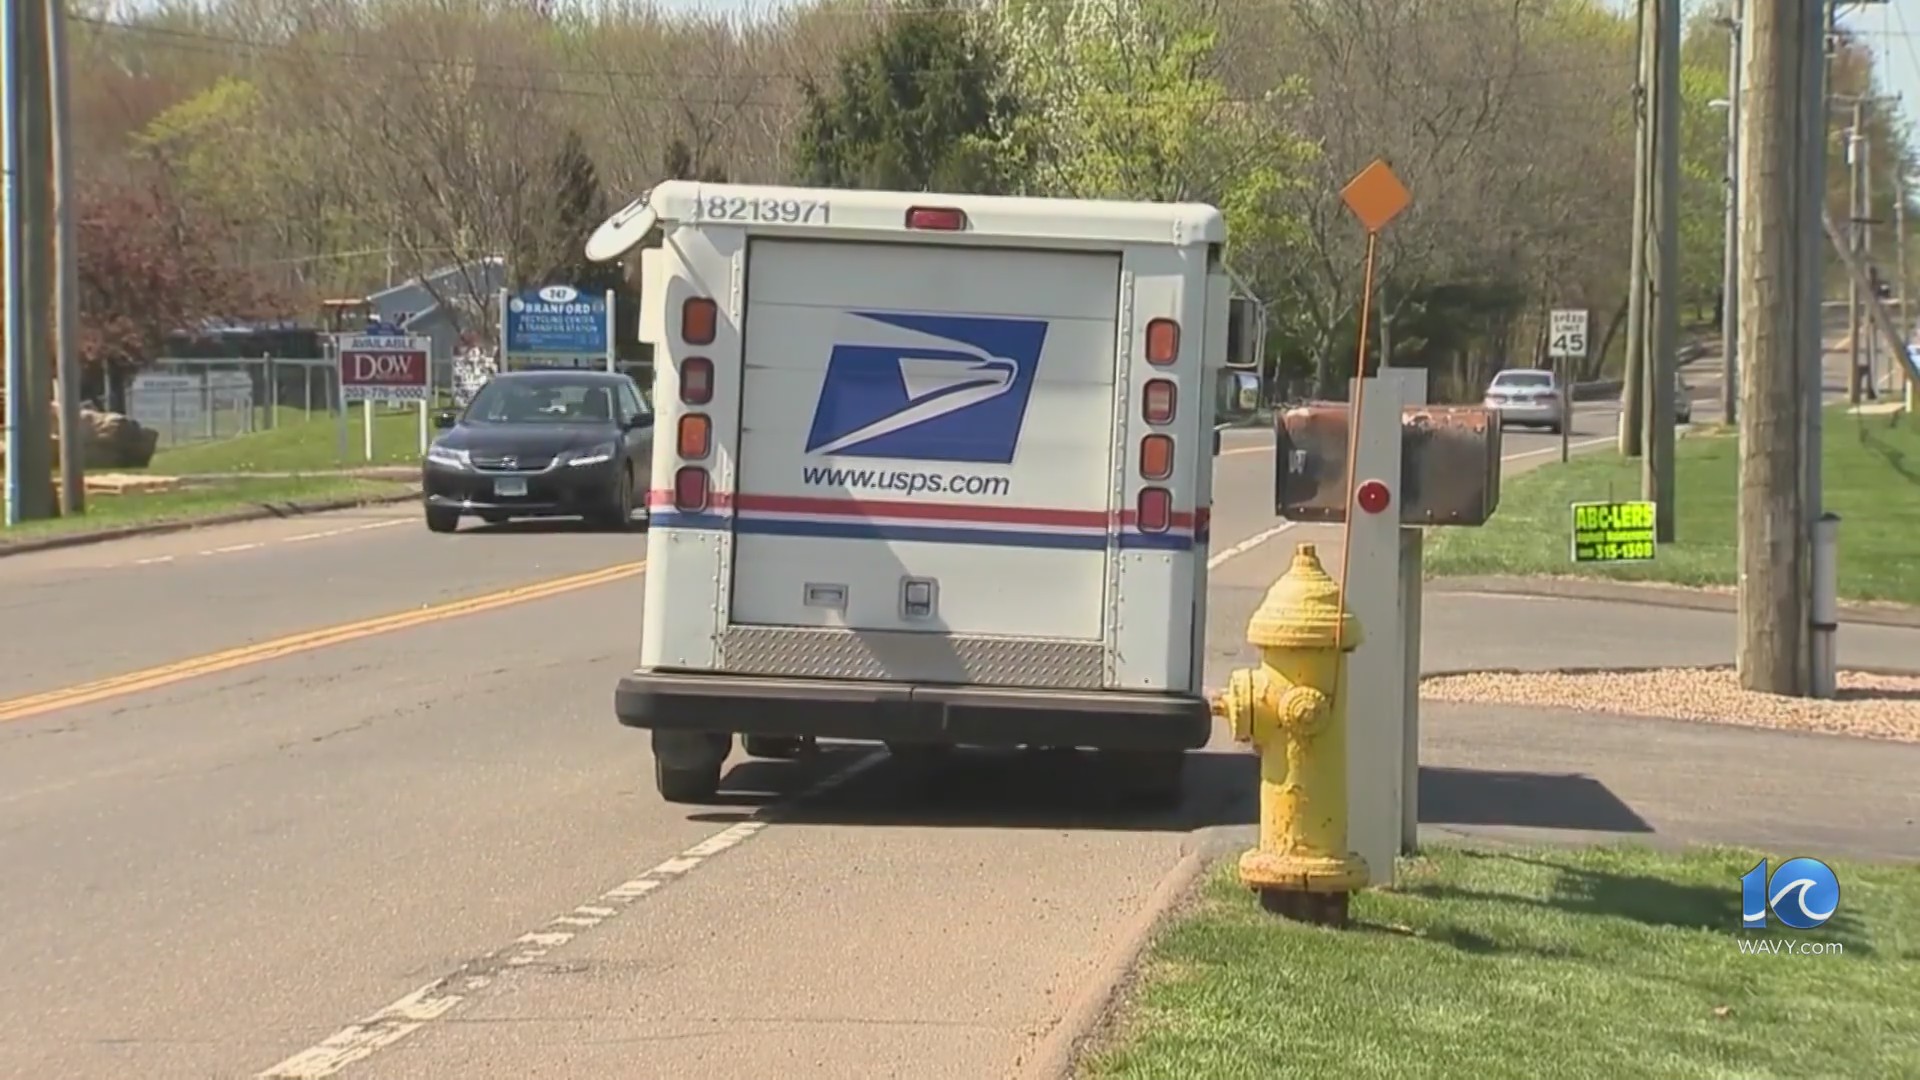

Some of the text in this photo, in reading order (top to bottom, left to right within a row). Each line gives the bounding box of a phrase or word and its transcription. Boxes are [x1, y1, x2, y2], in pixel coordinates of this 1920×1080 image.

[525, 303, 591, 314] BRANFORD
[1554, 313, 1585, 323] SPEED
[1555, 325, 1580, 333] LIMIT
[352, 338, 416, 348] AVAILABLE
[1553, 334, 1584, 352] 45
[803, 467, 1010, 496] www.usps.com
